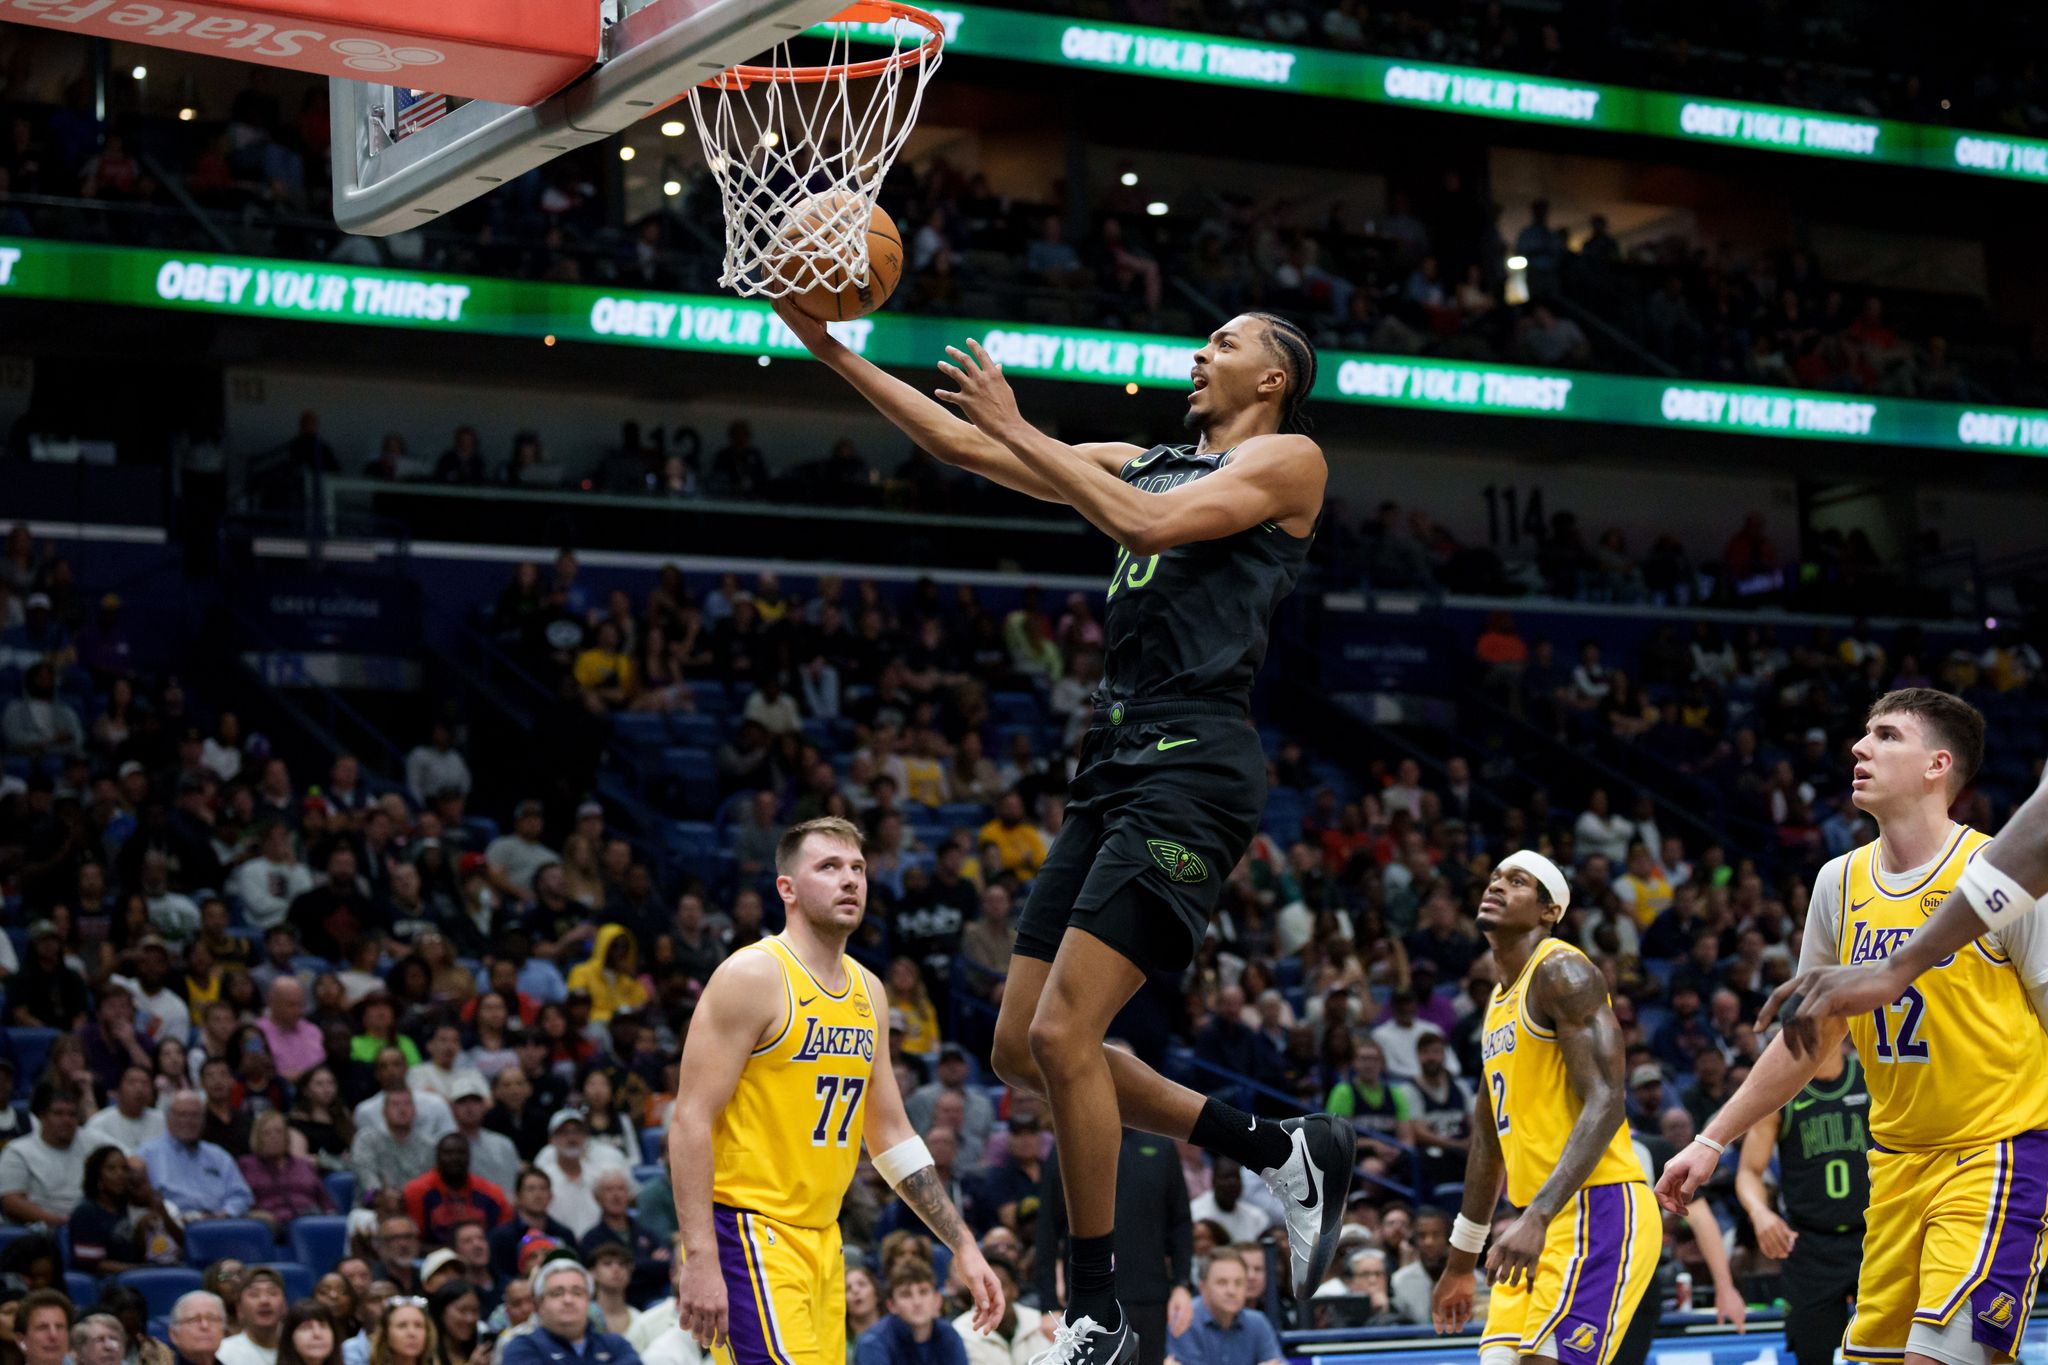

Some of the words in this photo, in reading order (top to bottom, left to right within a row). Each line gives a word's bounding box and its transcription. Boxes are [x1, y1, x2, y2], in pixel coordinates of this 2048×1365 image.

[157, 260, 252, 304] OBEY
[351, 277, 470, 321] THIRST
[591, 297, 677, 338] OBEY
[791, 1016, 874, 1063] LAKERS
[1873, 984, 1931, 1064] 12
[811, 1075, 865, 1147] 77
[1492, 1071, 1511, 1137] 2
[1825, 1158, 1850, 1199] 0
